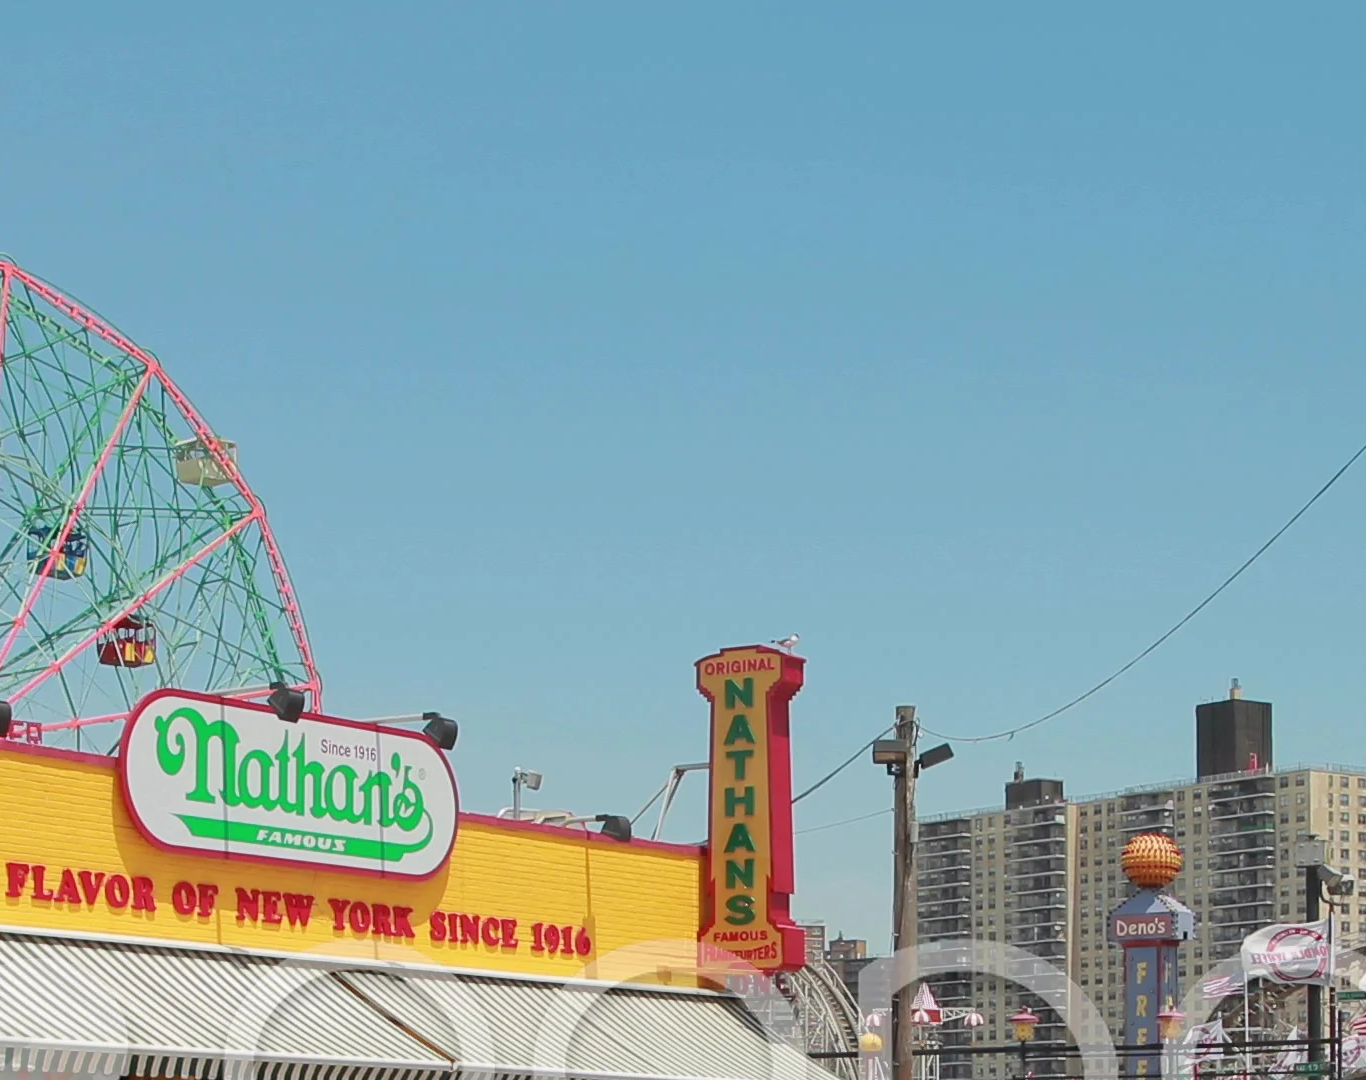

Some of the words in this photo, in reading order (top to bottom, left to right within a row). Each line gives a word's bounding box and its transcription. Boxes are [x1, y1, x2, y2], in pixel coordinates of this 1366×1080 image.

[705, 657, 776, 675] ORIGINAL
[321, 739, 351, 758] Since
[354, 745, 377, 762] 1916
[154, 707, 426, 832] Nathan's
[723, 677, 756, 925] NATHANS
[256, 829, 347, 852] FAMOUS
[6, 862, 157, 912] FLAVOR
[172, 881, 218, 918] OF
[236, 887, 315, 926] NEW
[329, 898, 416, 939] YORK
[430, 910, 518, 948] SINCE
[531, 921, 592, 956] 1916
[713, 930, 768, 942] FAMOUS
[1116, 918, 1166, 936] Deno's
